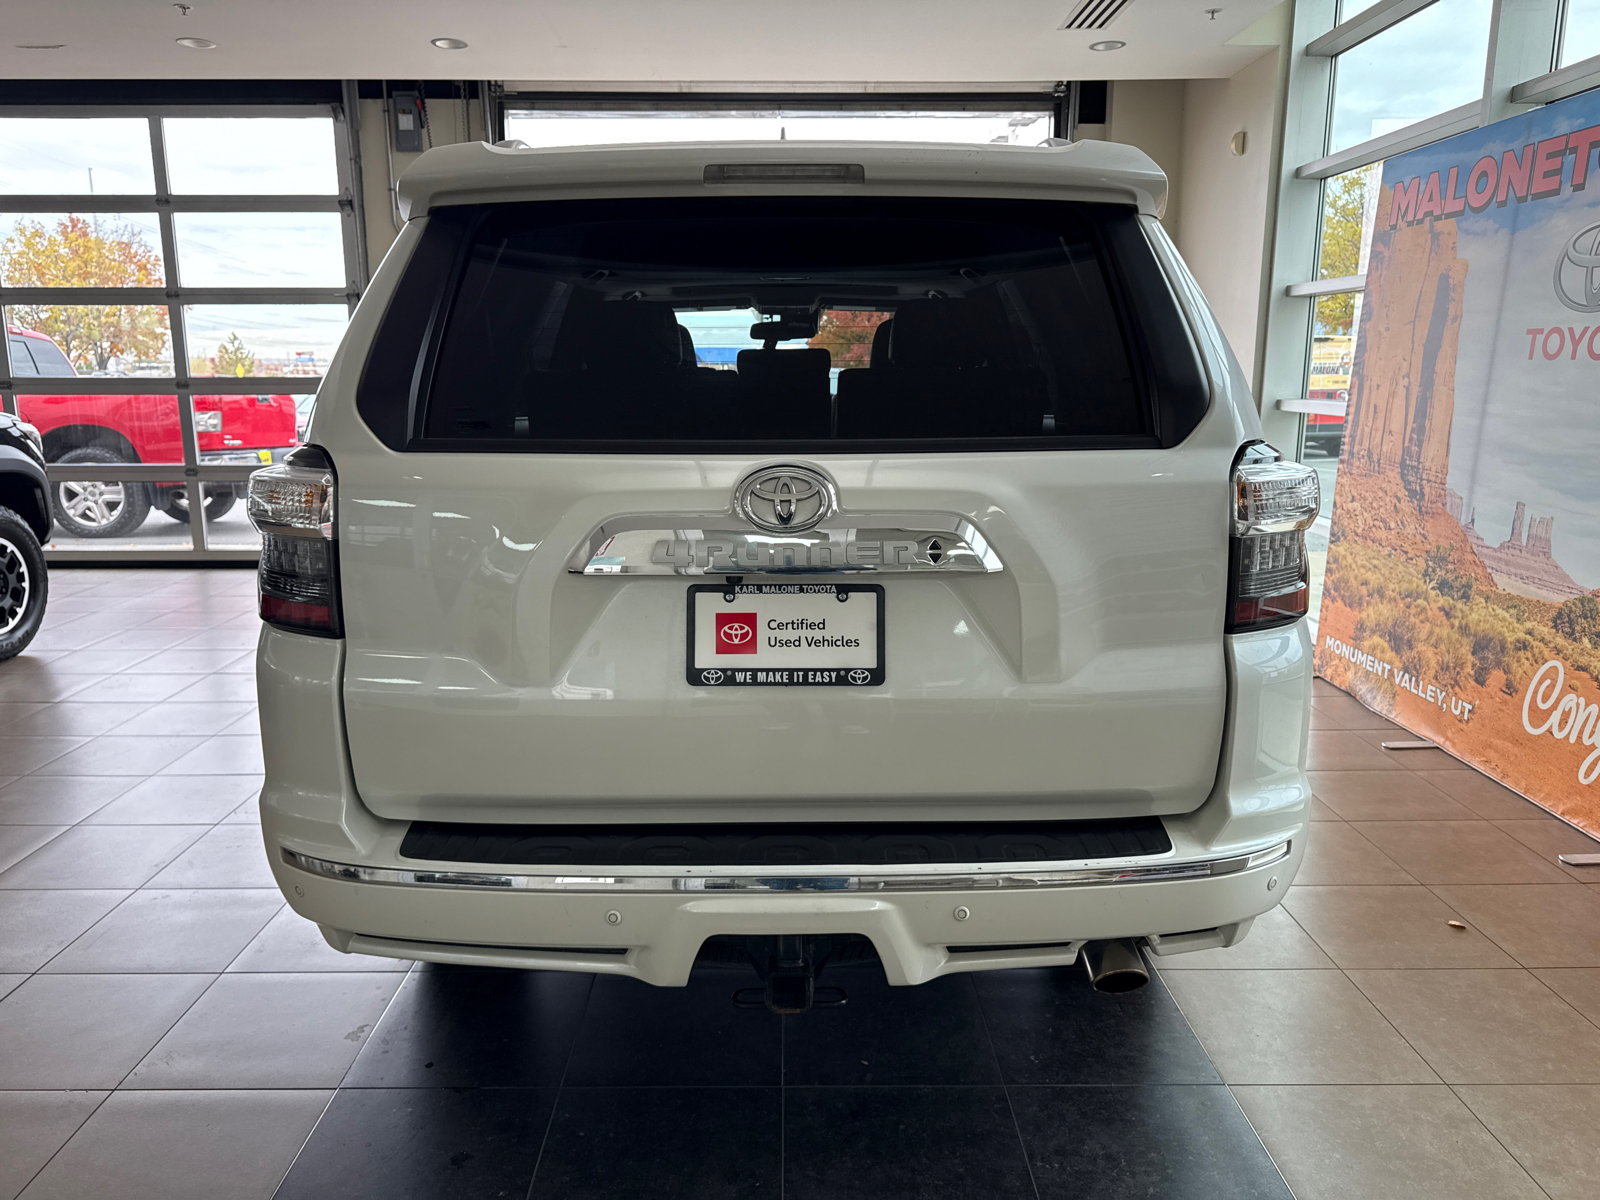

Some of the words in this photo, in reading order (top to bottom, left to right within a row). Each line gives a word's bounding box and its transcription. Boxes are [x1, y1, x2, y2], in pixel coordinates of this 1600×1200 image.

[1389, 123, 1600, 231] MALONET
[734, 585, 760, 594] KARL
[762, 585, 800, 594] MALONE
[802, 585, 837, 594] TOYOTA
[767, 618, 826, 631] Certified
[767, 636, 801, 648] Used
[805, 635, 860, 648] Vehicles
[735, 671, 753, 683] WE
[757, 671, 789, 683] MAKE
[793, 671, 804, 683] IT
[808, 671, 837, 683] EASY
[1325, 635, 1391, 679] MONUMENT
[1394, 668, 1447, 713] VALLEY,
[1451, 696, 1473, 720] UT
